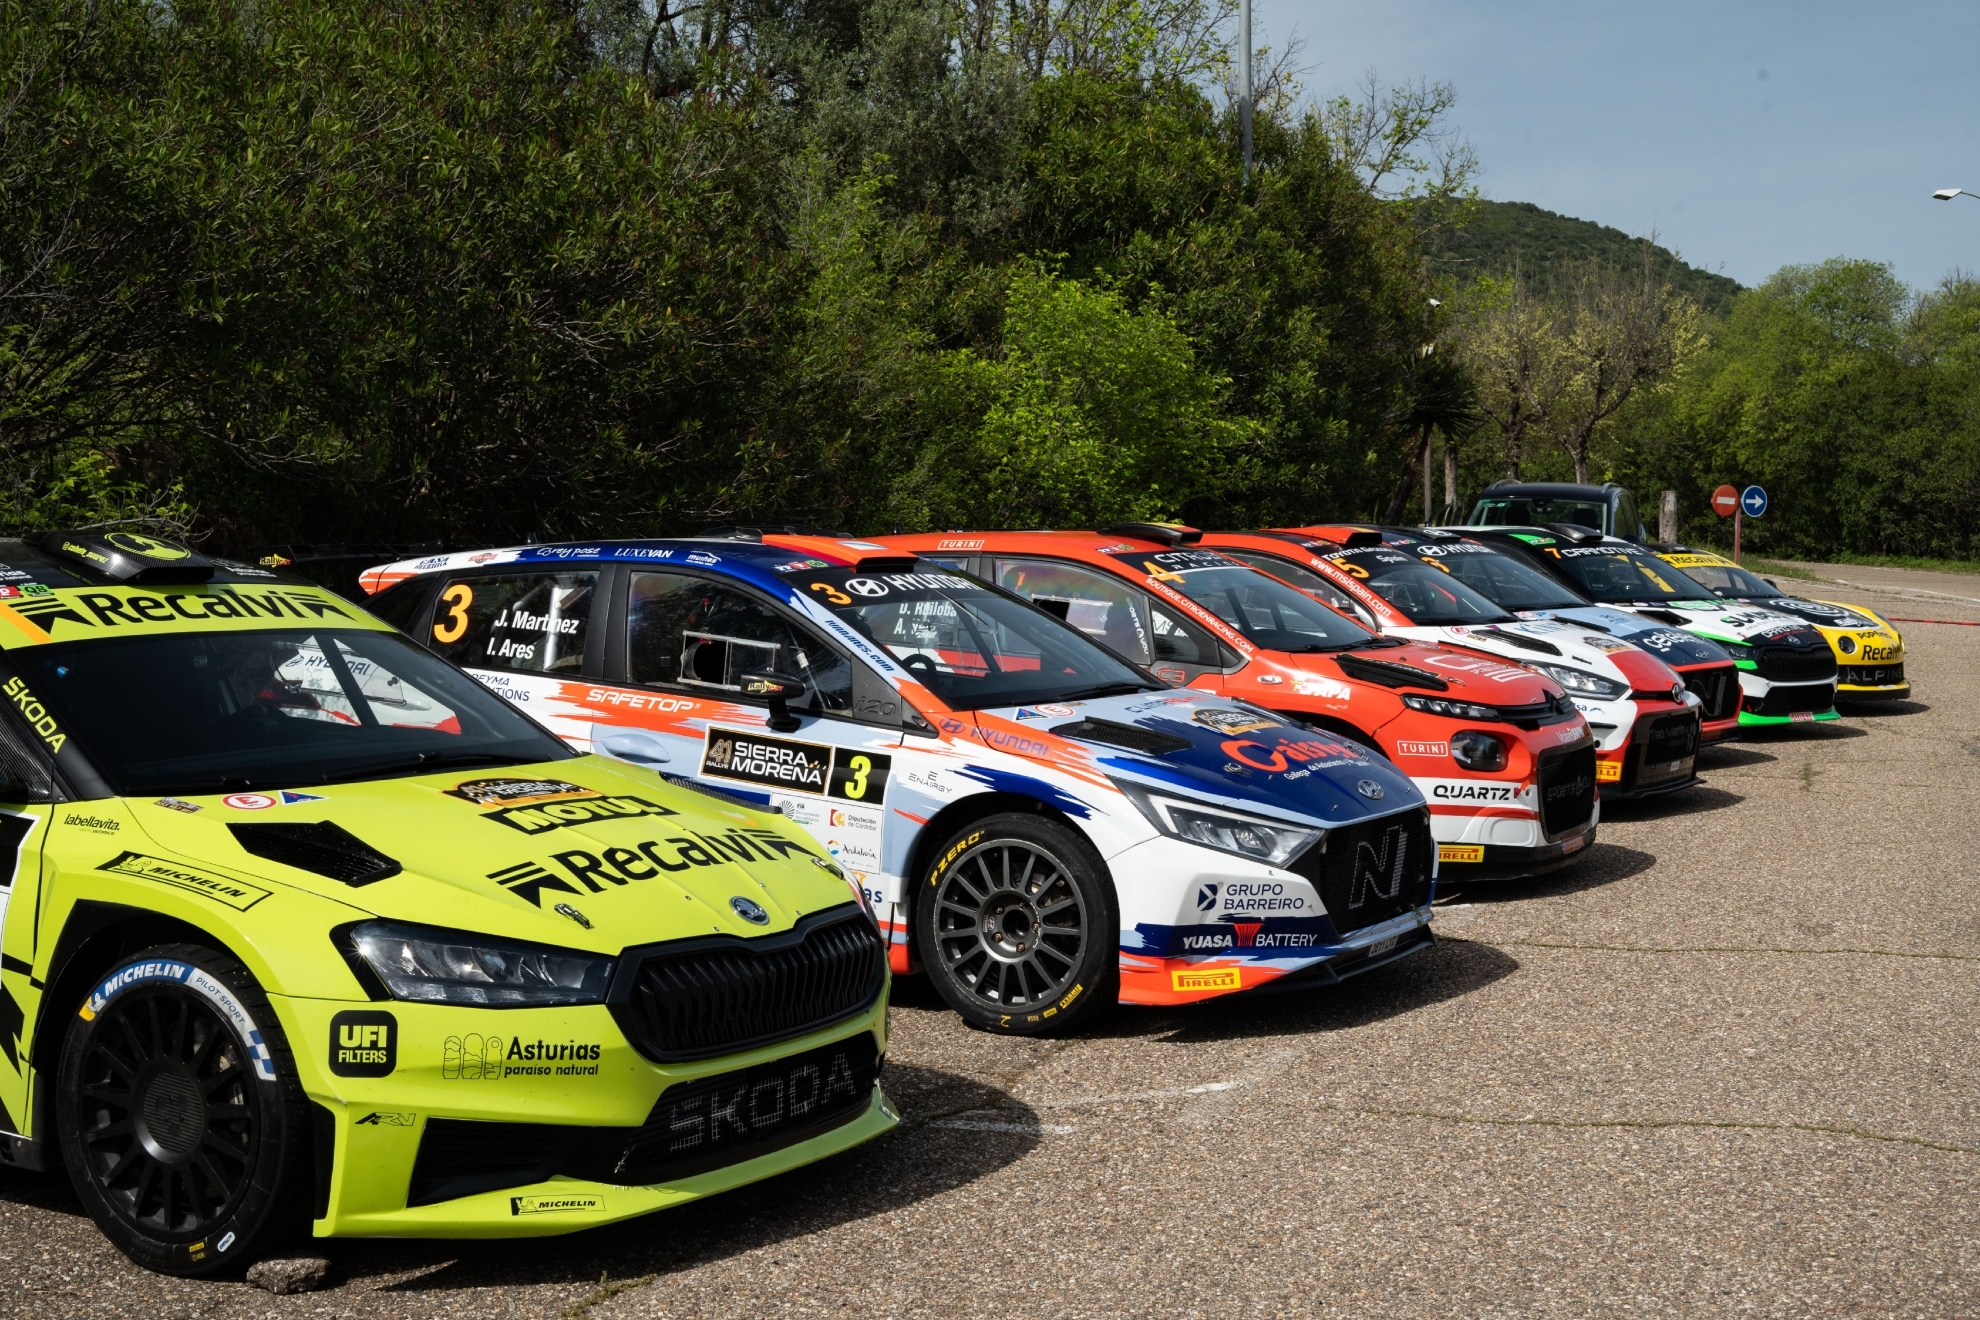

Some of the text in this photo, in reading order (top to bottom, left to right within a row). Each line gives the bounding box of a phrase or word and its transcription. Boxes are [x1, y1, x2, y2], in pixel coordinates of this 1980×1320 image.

[614, 548, 674, 558] LUXEVAN
[1321, 547, 1362, 562] TOYOTA
[1544, 548, 1562, 559] 7
[1143, 561, 1186, 584] 4
[1331, 558, 1369, 579] 5
[810, 582, 852, 605] 3
[882, 574, 985, 591] HYUNDAI
[1311, 558, 1392, 617] www.msispain.com
[75, 590, 310, 627] Recalvi
[434, 584, 474, 643] 3
[494, 609, 508, 627] J.
[1145, 578, 1255, 654] BOUTIQUE.CITROENRACING.COM
[486, 637, 535, 660] I. Ares
[1157, 668, 1187, 683] C3
[586, 689, 694, 713] SAFETOP
[854, 695, 896, 716] i20
[708, 738, 733, 763] 41
[970, 727, 1049, 757] HYUNDAI
[1401, 743, 1445, 754] TURINI
[706, 760, 729, 769] RALLYE
[734, 741, 809, 768] SIERRA
[731, 756, 822, 785] MORENA
[844, 755, 872, 799] 3
[908, 773, 953, 793] ENAIRGY
[1433, 784, 1511, 801] QUARTZ
[502, 798, 666, 831] MOTUL
[848, 814, 877, 825] Diputación
[855, 823, 877, 832] Córdoba
[548, 828, 780, 893] Recalvi
[930, 832, 980, 887] P ZERO
[1348, 823, 1408, 911] N
[147, 864, 247, 899] MICHELIN
[1226, 884, 1284, 897] GRUPO
[1223, 897, 1304, 911] BARREIRO
[1182, 933, 1318, 949] YUASA BATTERY
[1176, 972, 1242, 988] PIRELLI
[105, 963, 246, 1024] MICHELIN PILOT SPORT
[338, 1024, 388, 1049] UFI
[338, 1049, 388, 1065] FILTERS
[506, 1036, 601, 1062] Asturias
[504, 1062, 600, 1078] paraíso natural
[538, 1198, 597, 1209] MICHELIN
